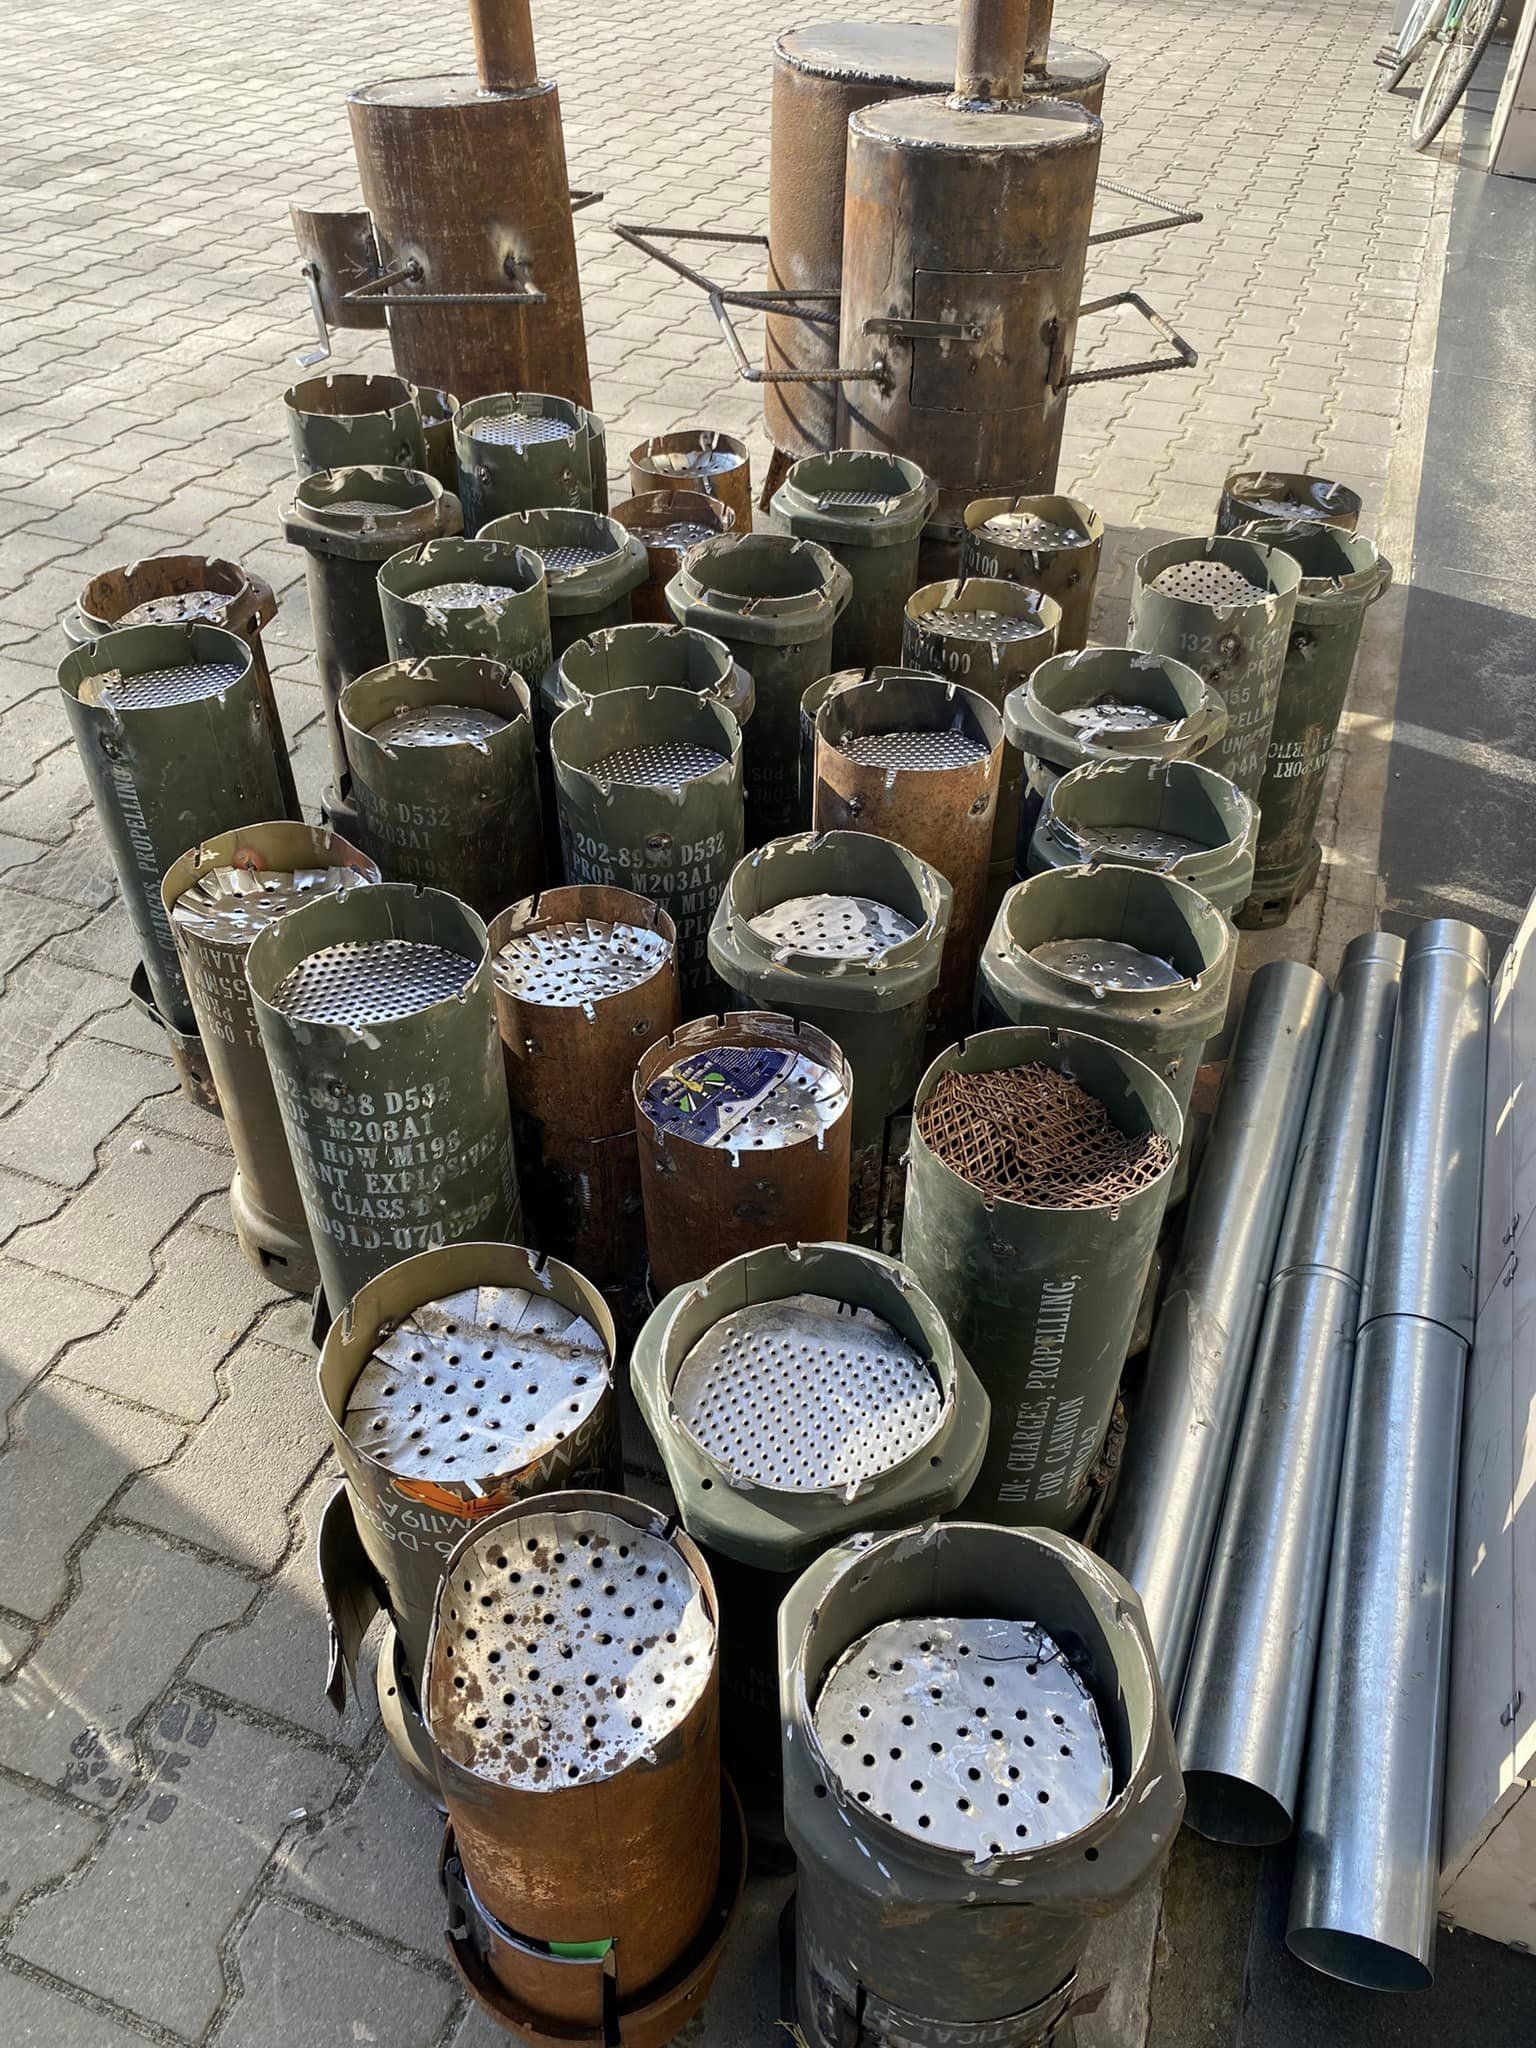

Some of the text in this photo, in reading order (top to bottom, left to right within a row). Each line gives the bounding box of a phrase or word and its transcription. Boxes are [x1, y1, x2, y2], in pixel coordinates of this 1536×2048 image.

[680, 830, 725, 867] D532
[326, 1112, 436, 1144] M203A1
[319, 1138, 379, 1170] HOW
[330, 1189, 407, 1221] CLASS
[1034, 1393, 1087, 1502] FOR CANNON
